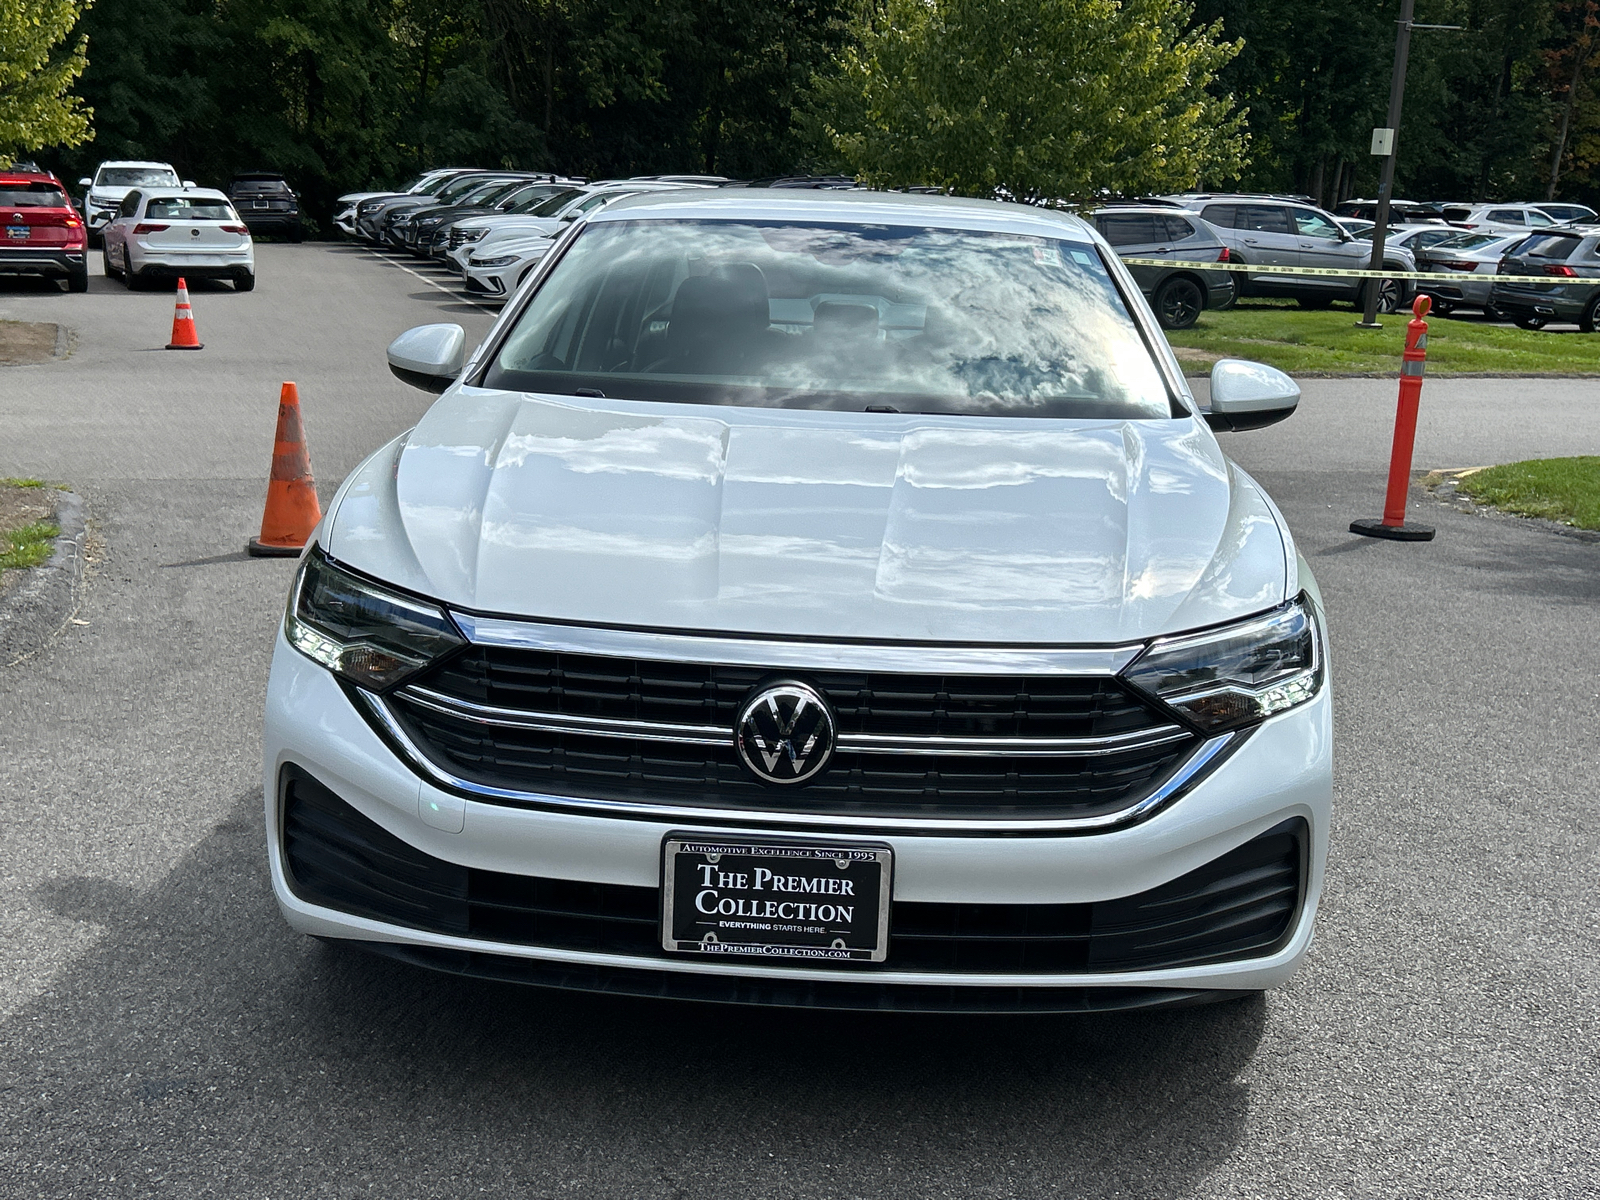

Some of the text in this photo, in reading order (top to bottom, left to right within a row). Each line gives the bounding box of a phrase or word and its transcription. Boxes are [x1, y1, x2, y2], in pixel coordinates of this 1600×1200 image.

[683, 844, 875, 861] AUTOMOTIVE EXCELLENCE SINCE 1995
[697, 864, 855, 896] THE PREMIER
[695, 890, 854, 923] COLLECTION
[719, 920, 772, 931] EVERYTHING
[772, 924, 803, 933] STARTS
